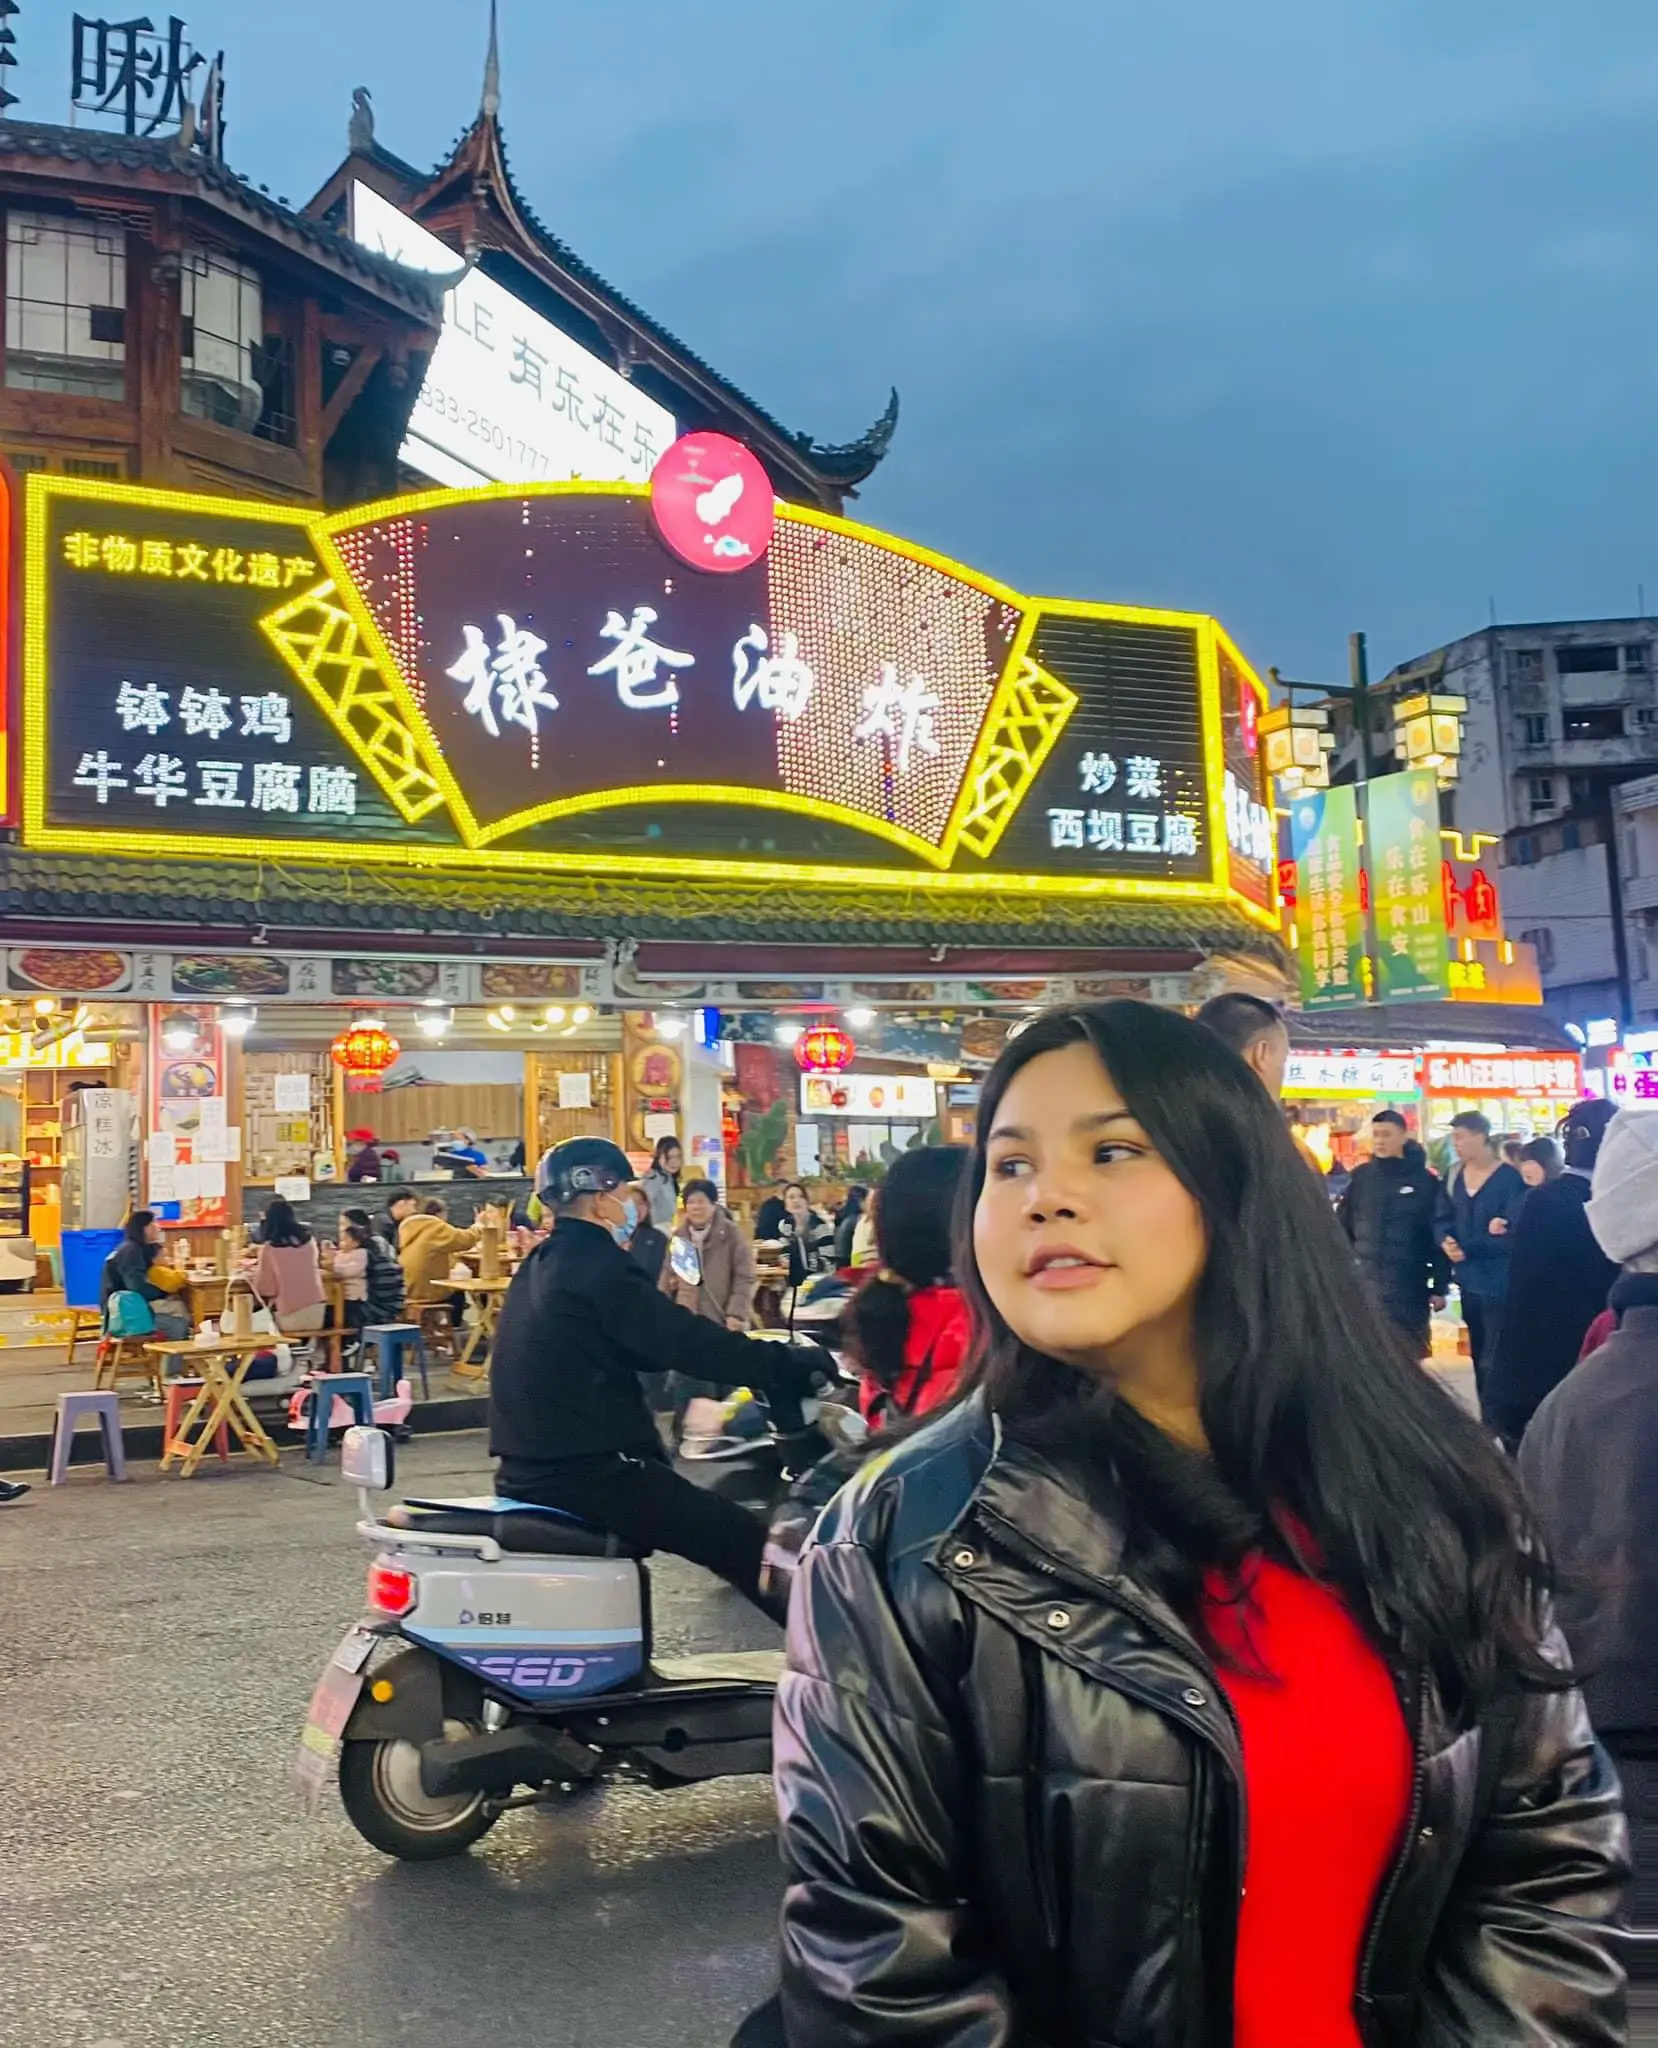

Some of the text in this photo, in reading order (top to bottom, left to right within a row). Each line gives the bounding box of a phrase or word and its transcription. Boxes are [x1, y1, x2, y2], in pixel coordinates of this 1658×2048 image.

[64, 532, 316, 588] 非物质文化遗产
[116, 680, 293, 743] 钵钵鸡
[73, 750, 358, 815] 牛华豆腐脑
[1079, 751, 1163, 799] 炒菜
[1046, 808, 1198, 856] 西坝豆腐
